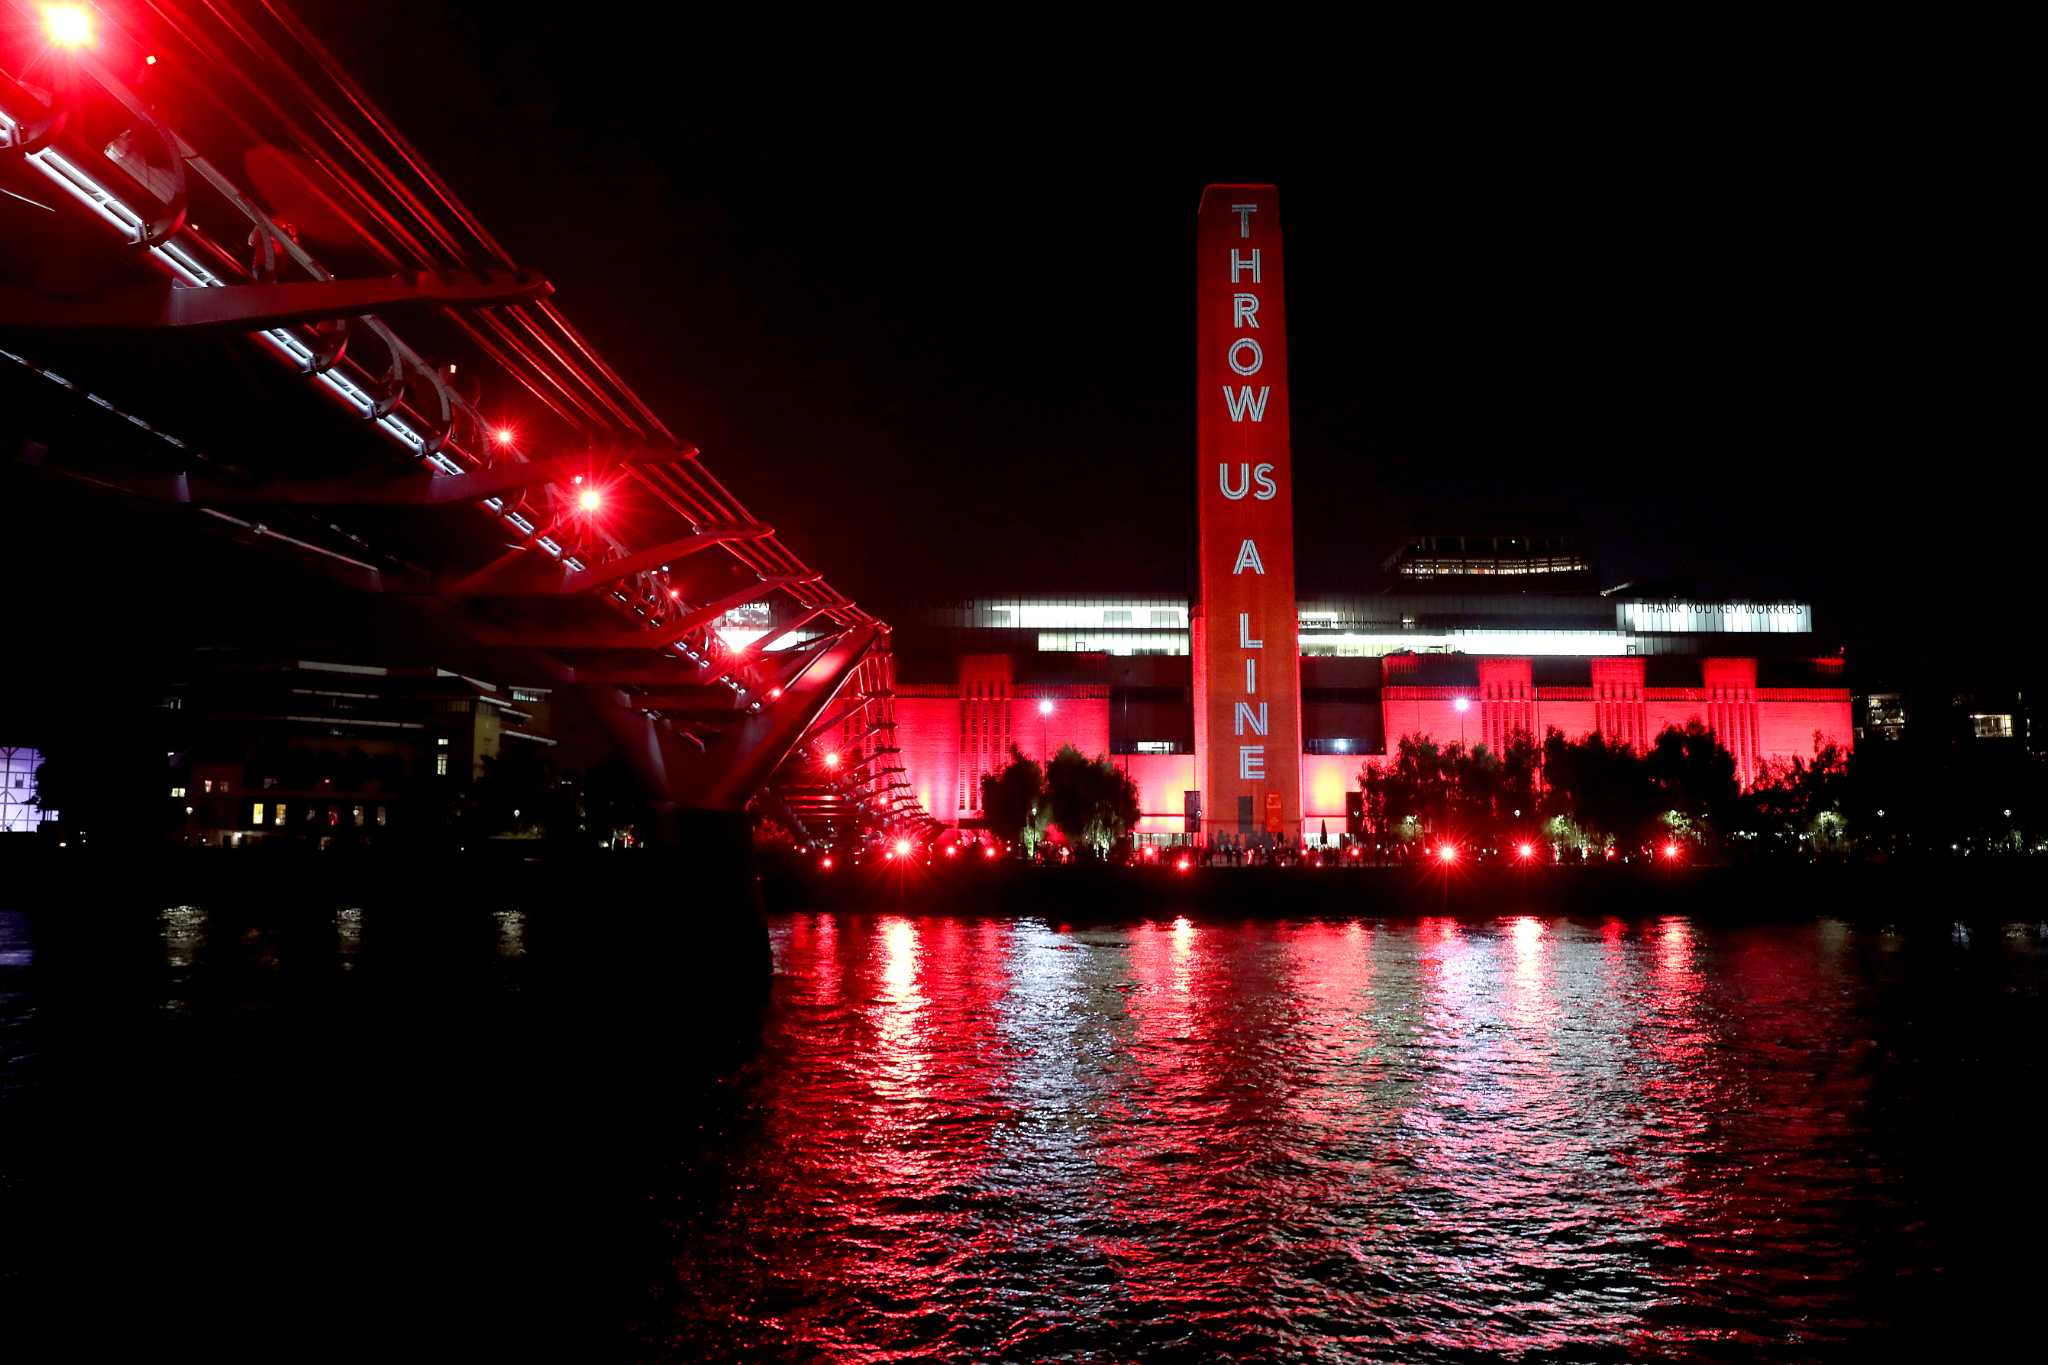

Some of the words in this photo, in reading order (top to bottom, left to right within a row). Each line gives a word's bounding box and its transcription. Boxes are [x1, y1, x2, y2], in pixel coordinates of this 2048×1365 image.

[1222, 203, 1271, 422] THROW
[1219, 463, 1277, 500] US
[1232, 539, 1265, 575] A
[1640, 601, 1681, 613] THANK
[1687, 601, 1711, 614] YOU
[1717, 602, 1740, 614] KEY
[1744, 602, 1803, 615] WORKERS
[1234, 612, 1268, 779] LINE
